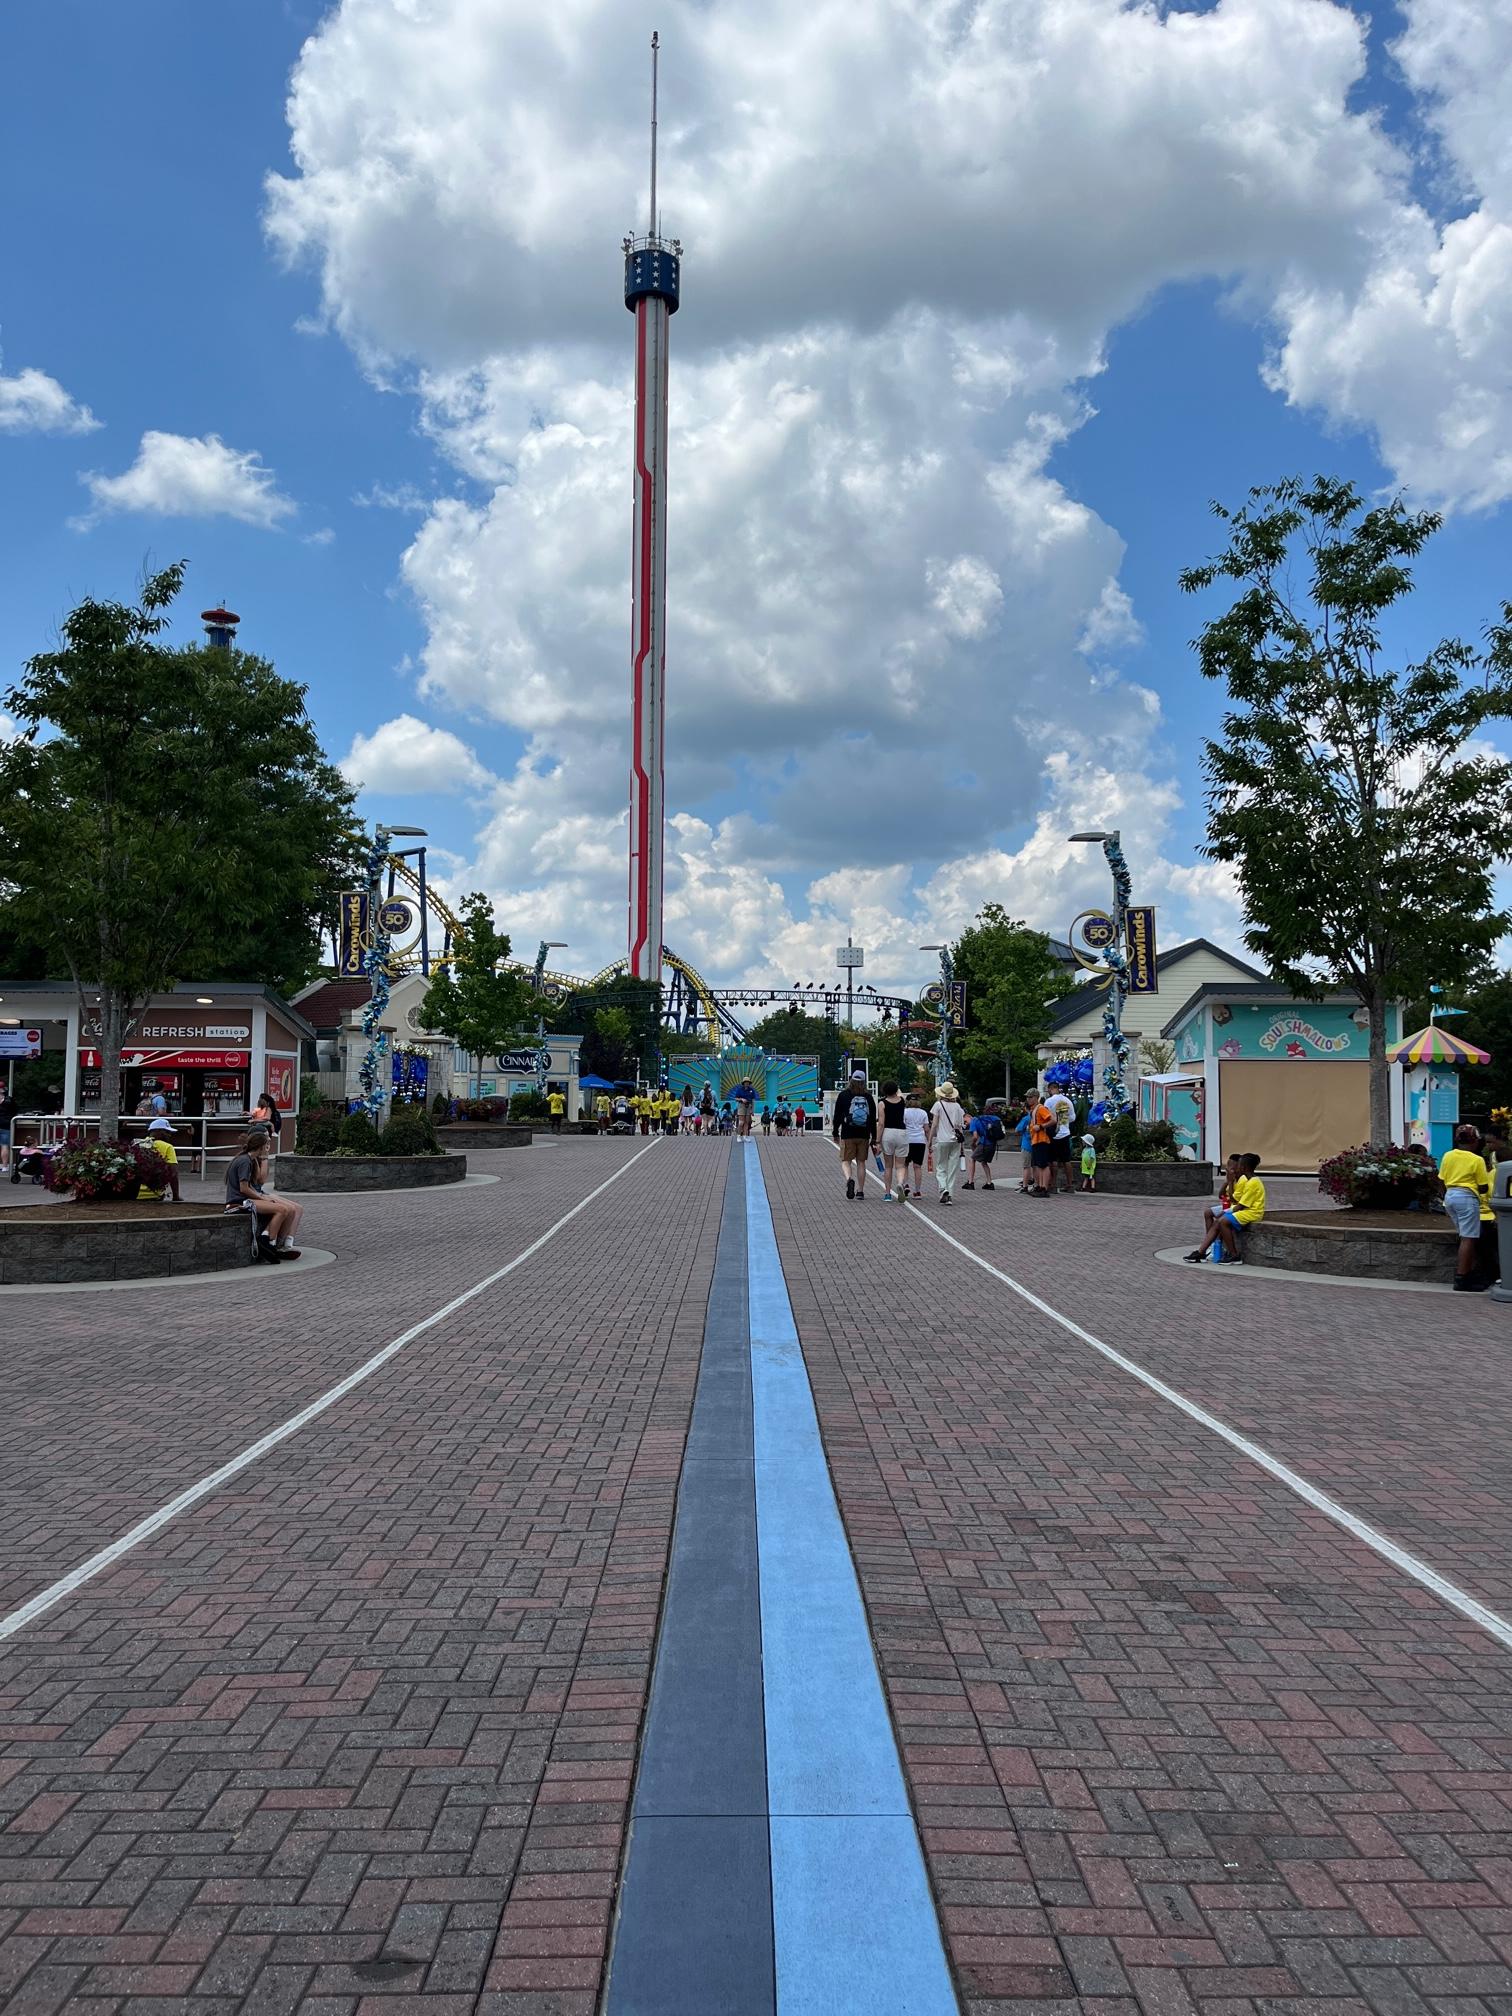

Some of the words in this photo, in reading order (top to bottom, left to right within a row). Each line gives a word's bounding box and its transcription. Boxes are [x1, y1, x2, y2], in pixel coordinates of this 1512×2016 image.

[386, 913, 404, 925] 50
[347, 895, 361, 972] Carowinds
[1090, 928, 1109, 940] 50
[1132, 912, 1148, 988] Carowinds
[953, 1012, 961, 1025] 50
[142, 1026, 204, 1037] REFRESH
[209, 1028, 245, 1036] station
[1260, 1019, 1351, 1052] SQUISHMALLOWS
